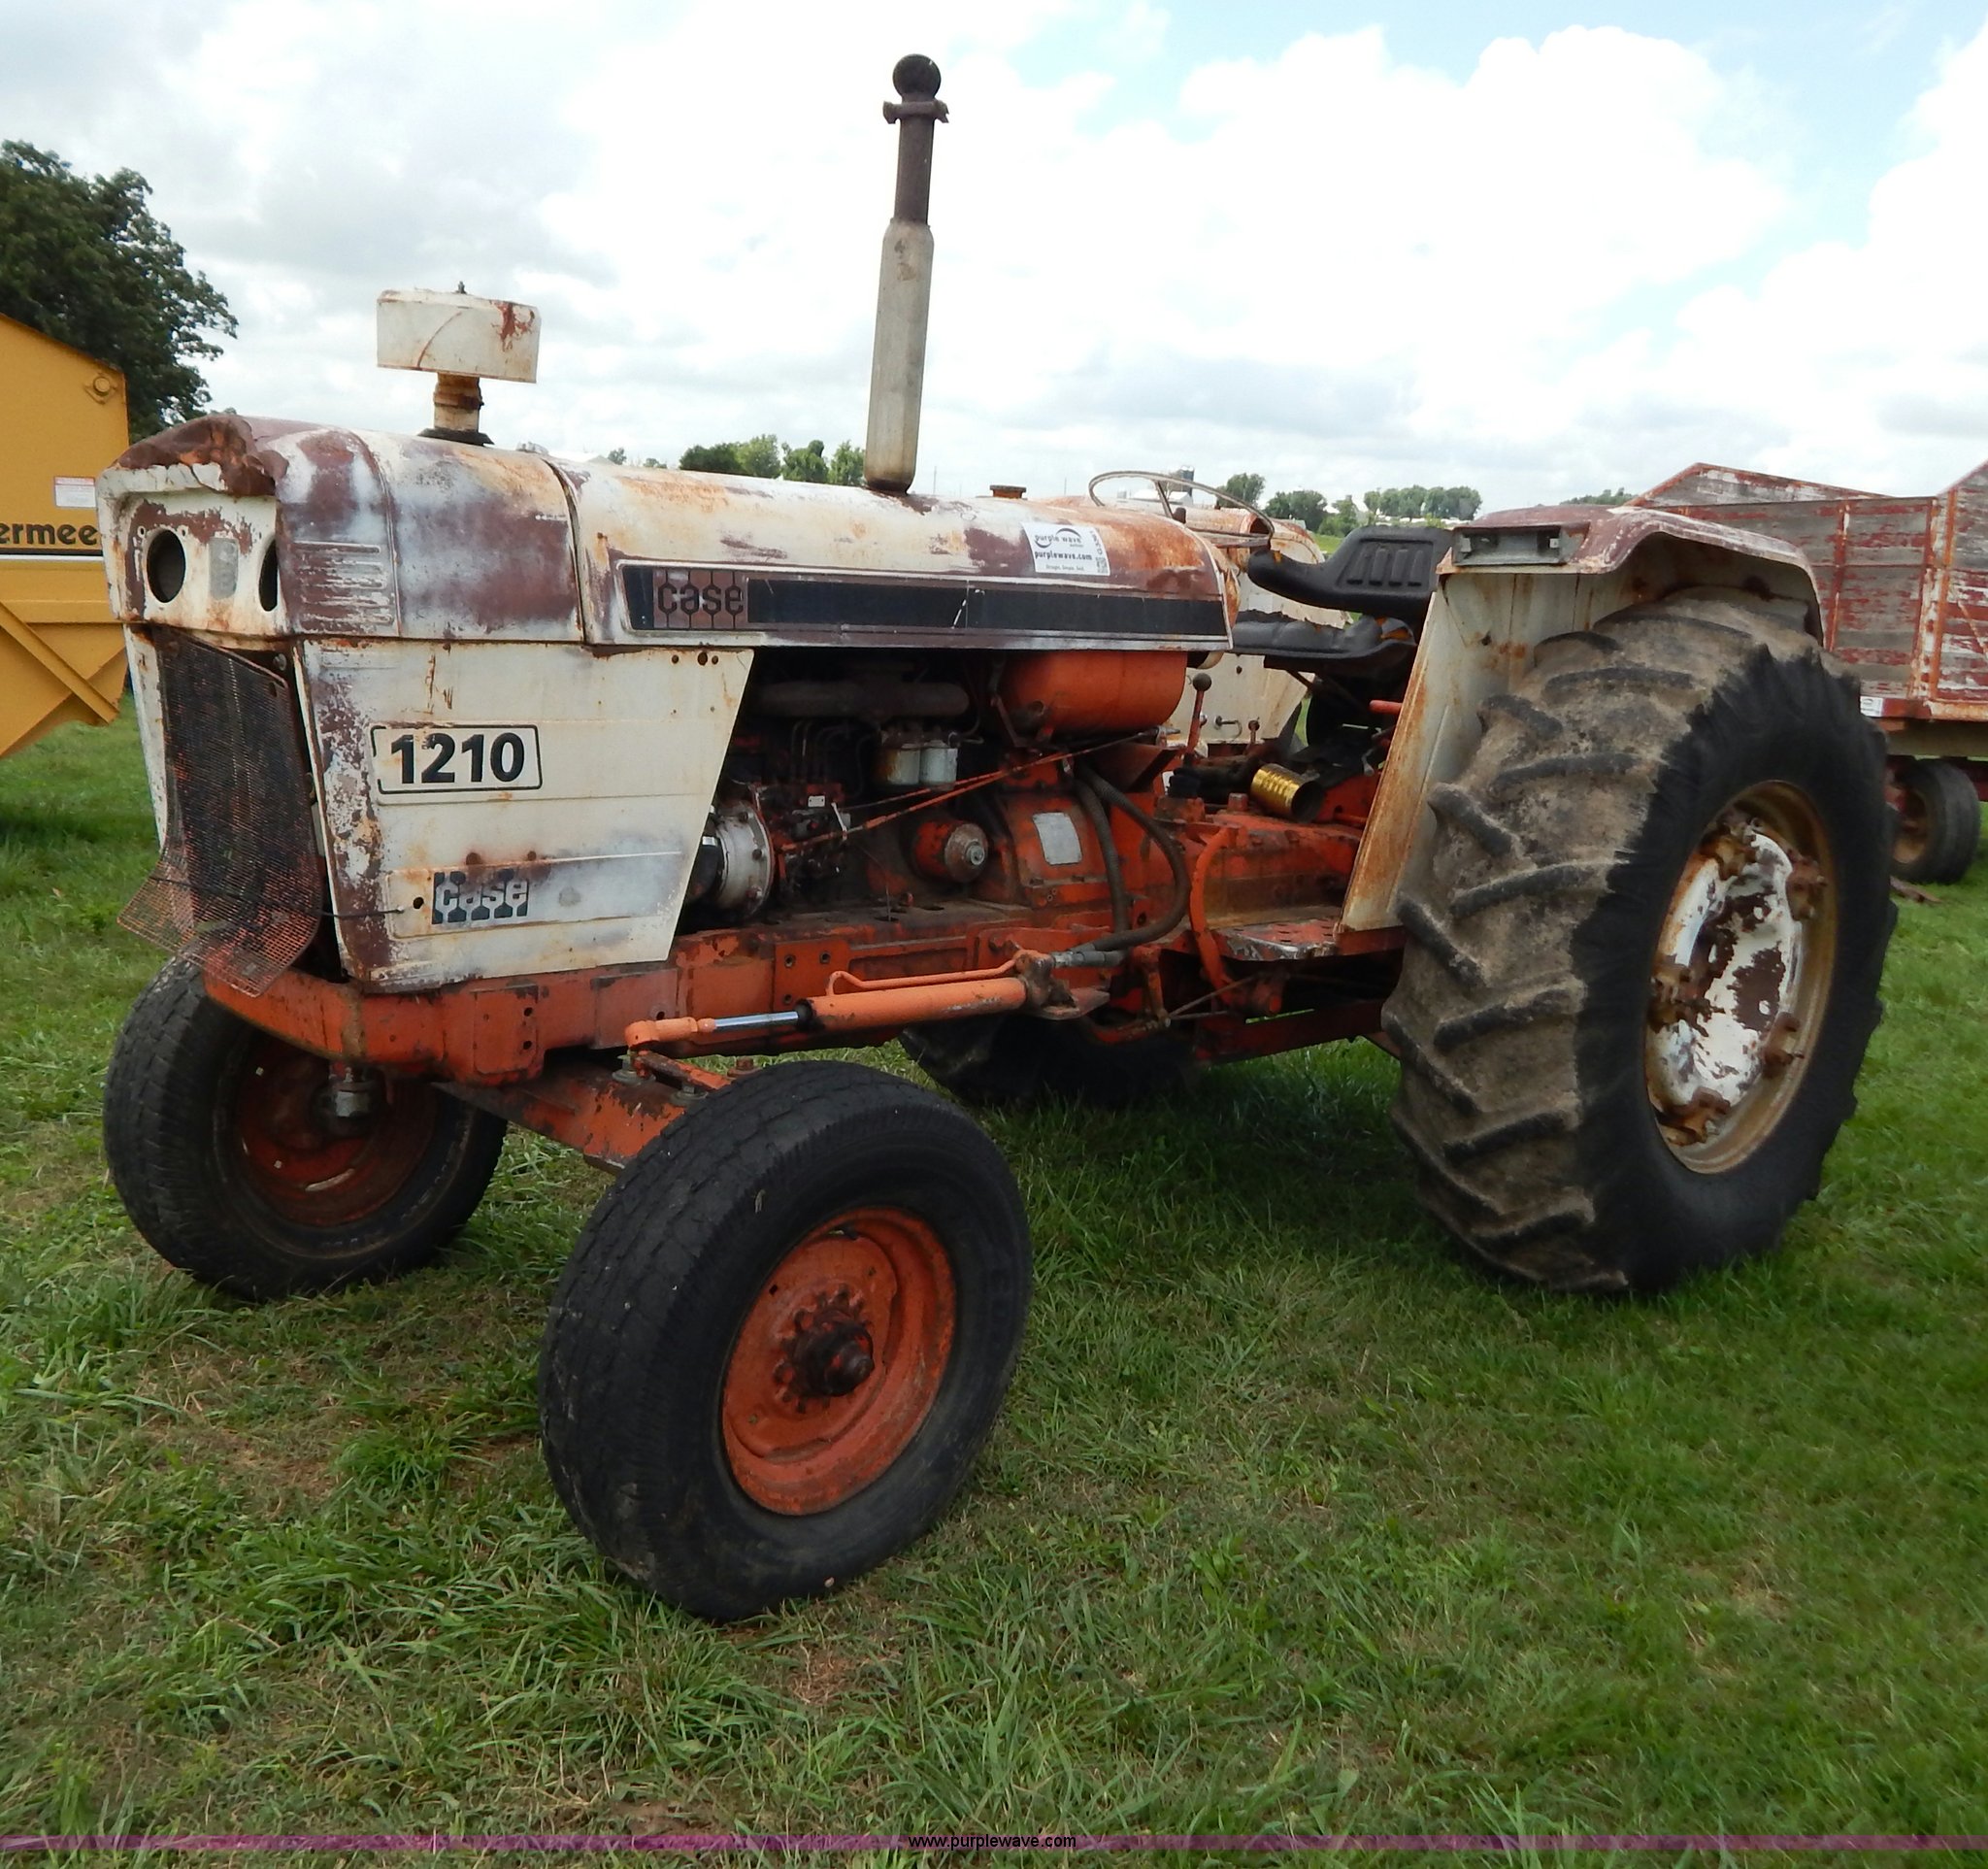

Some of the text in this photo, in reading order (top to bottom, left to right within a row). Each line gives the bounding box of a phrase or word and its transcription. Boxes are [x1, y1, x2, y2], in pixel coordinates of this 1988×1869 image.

[1035, 534, 1059, 543] purple
[1034, 550, 1093, 560] purplewave.com
[390, 731, 525, 784] 1210
